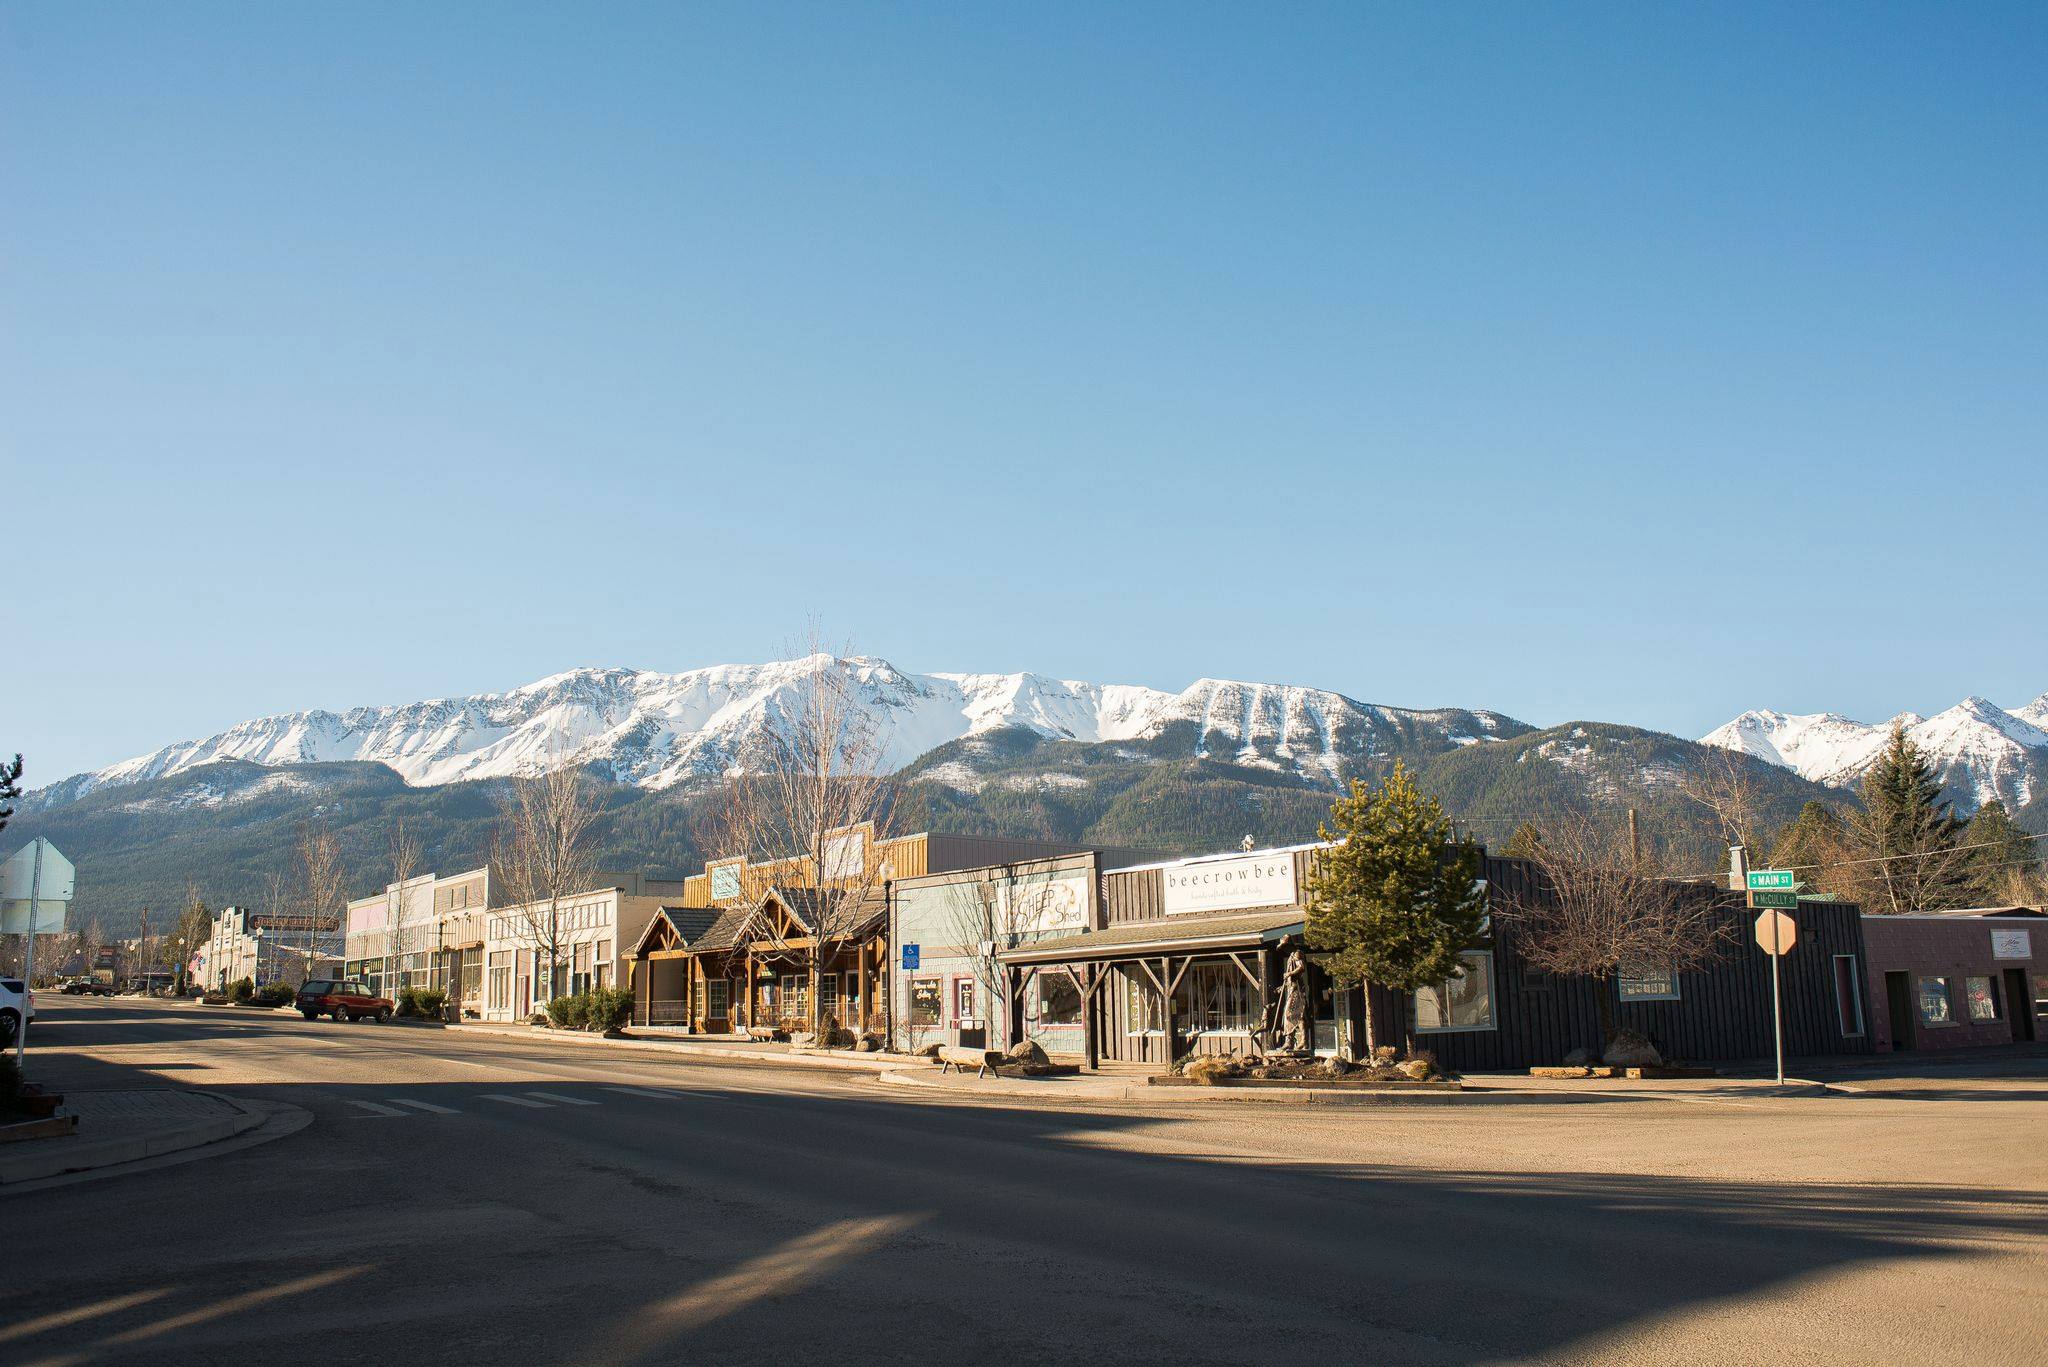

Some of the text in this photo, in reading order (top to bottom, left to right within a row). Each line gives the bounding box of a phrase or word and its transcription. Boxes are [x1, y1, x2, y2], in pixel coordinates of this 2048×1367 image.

[1169, 864, 1288, 888] beecrowbee
[1752, 875, 1789, 886] S MAIN ST
[1018, 889, 1055, 926] SHEEP
[1055, 903, 1082, 925] Shed
